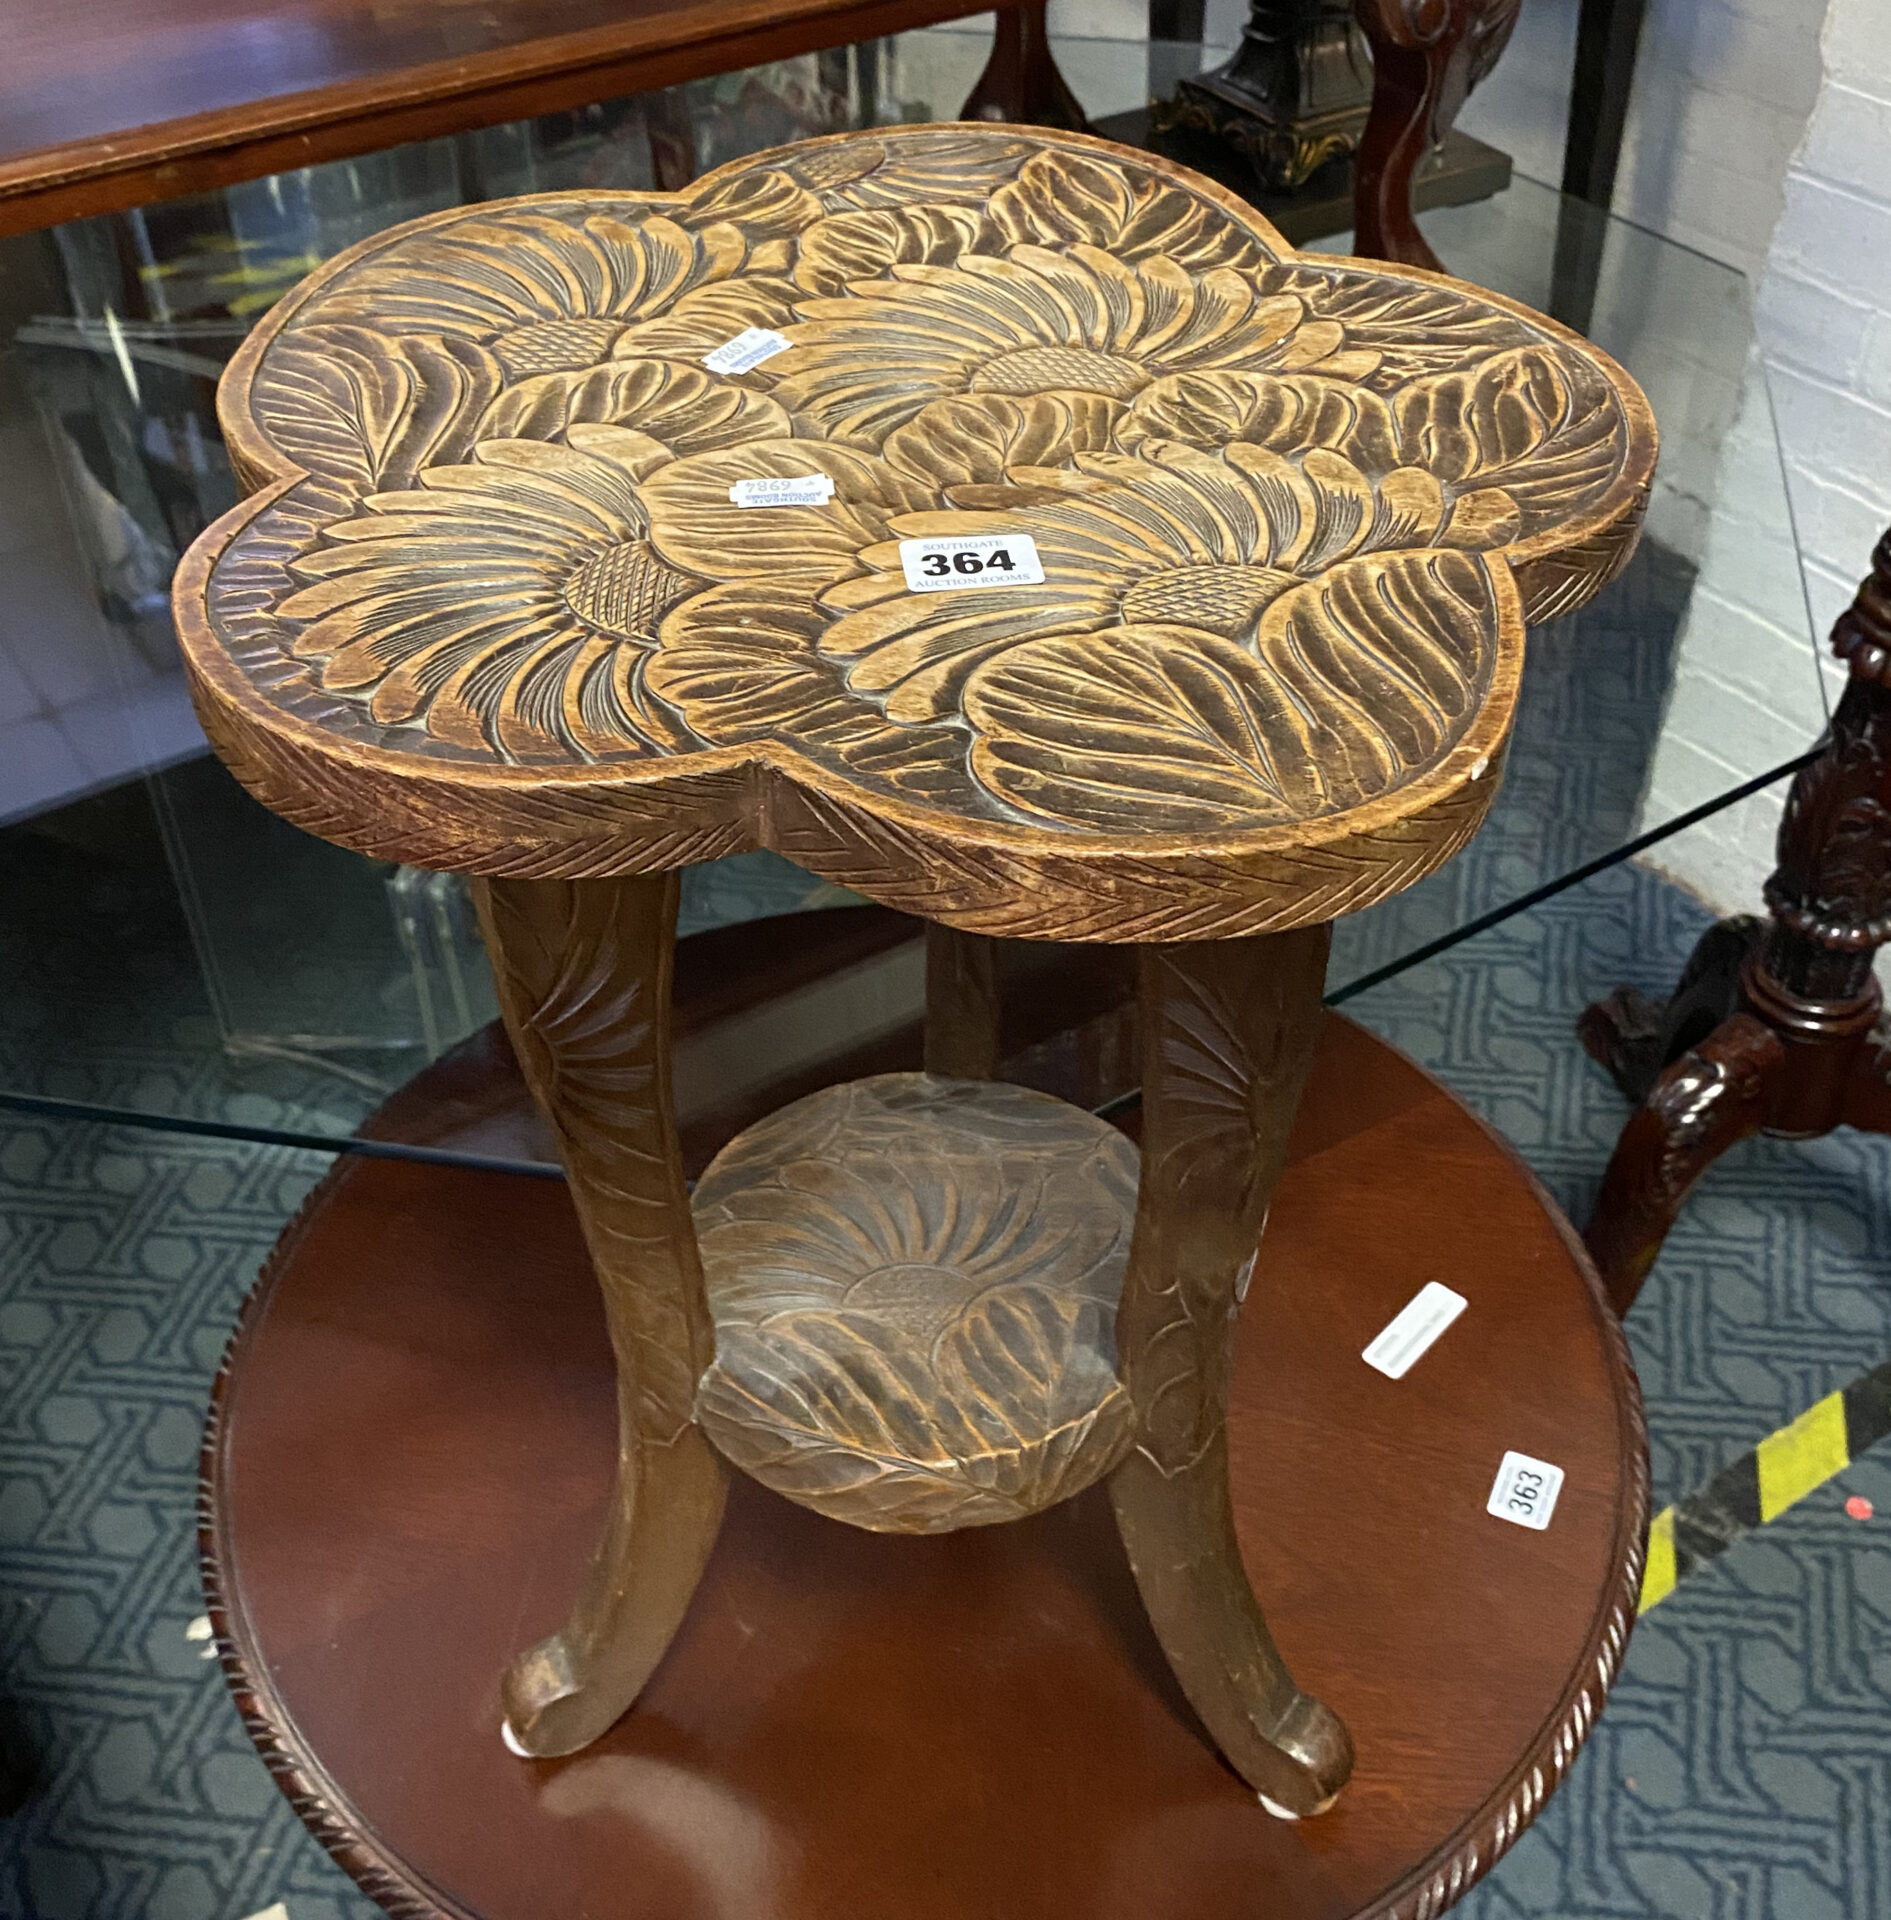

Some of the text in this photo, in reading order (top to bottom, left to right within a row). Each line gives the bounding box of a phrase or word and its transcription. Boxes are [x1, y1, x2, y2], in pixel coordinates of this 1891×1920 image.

[745, 480, 791, 493] 6984
[923, 540, 1004, 551] SOUTHGATE
[921, 549, 1016, 576] 364
[915, 573, 1031, 588] AUCTION ROOMS
[1508, 1470, 1543, 1515] 363
